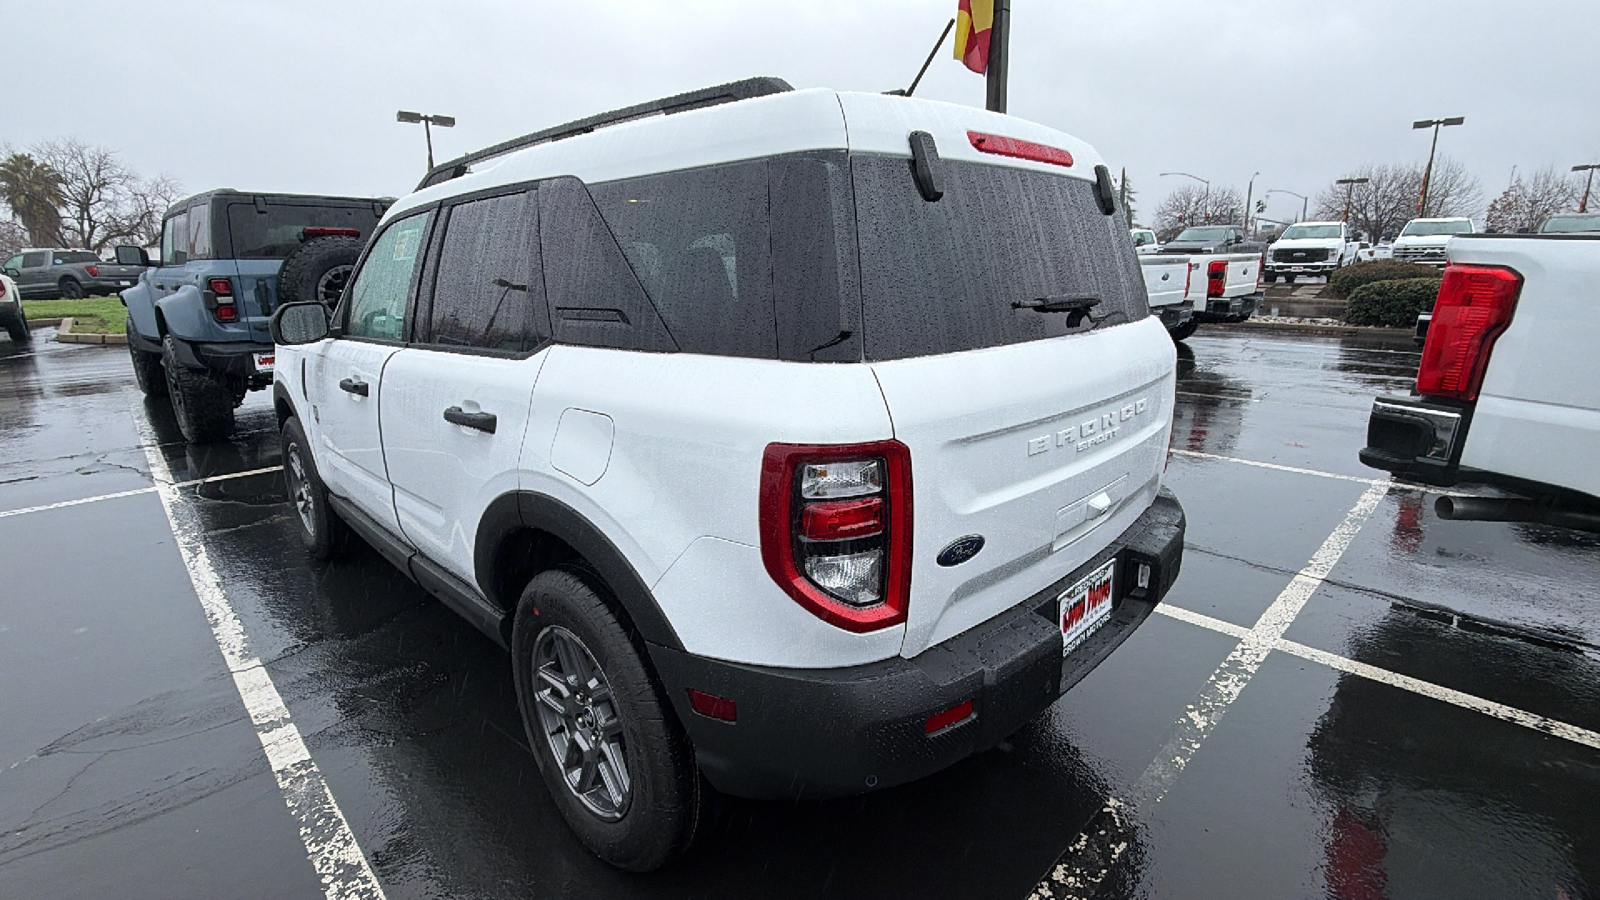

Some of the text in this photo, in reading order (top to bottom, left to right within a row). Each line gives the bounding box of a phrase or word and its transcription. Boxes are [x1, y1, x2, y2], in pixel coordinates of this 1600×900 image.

[1028, 397, 1148, 456] BRONCO
[1076, 427, 1120, 452] SPORT
[1063, 632, 1086, 658] CROWN
[1086, 611, 1111, 638] MOTORS
